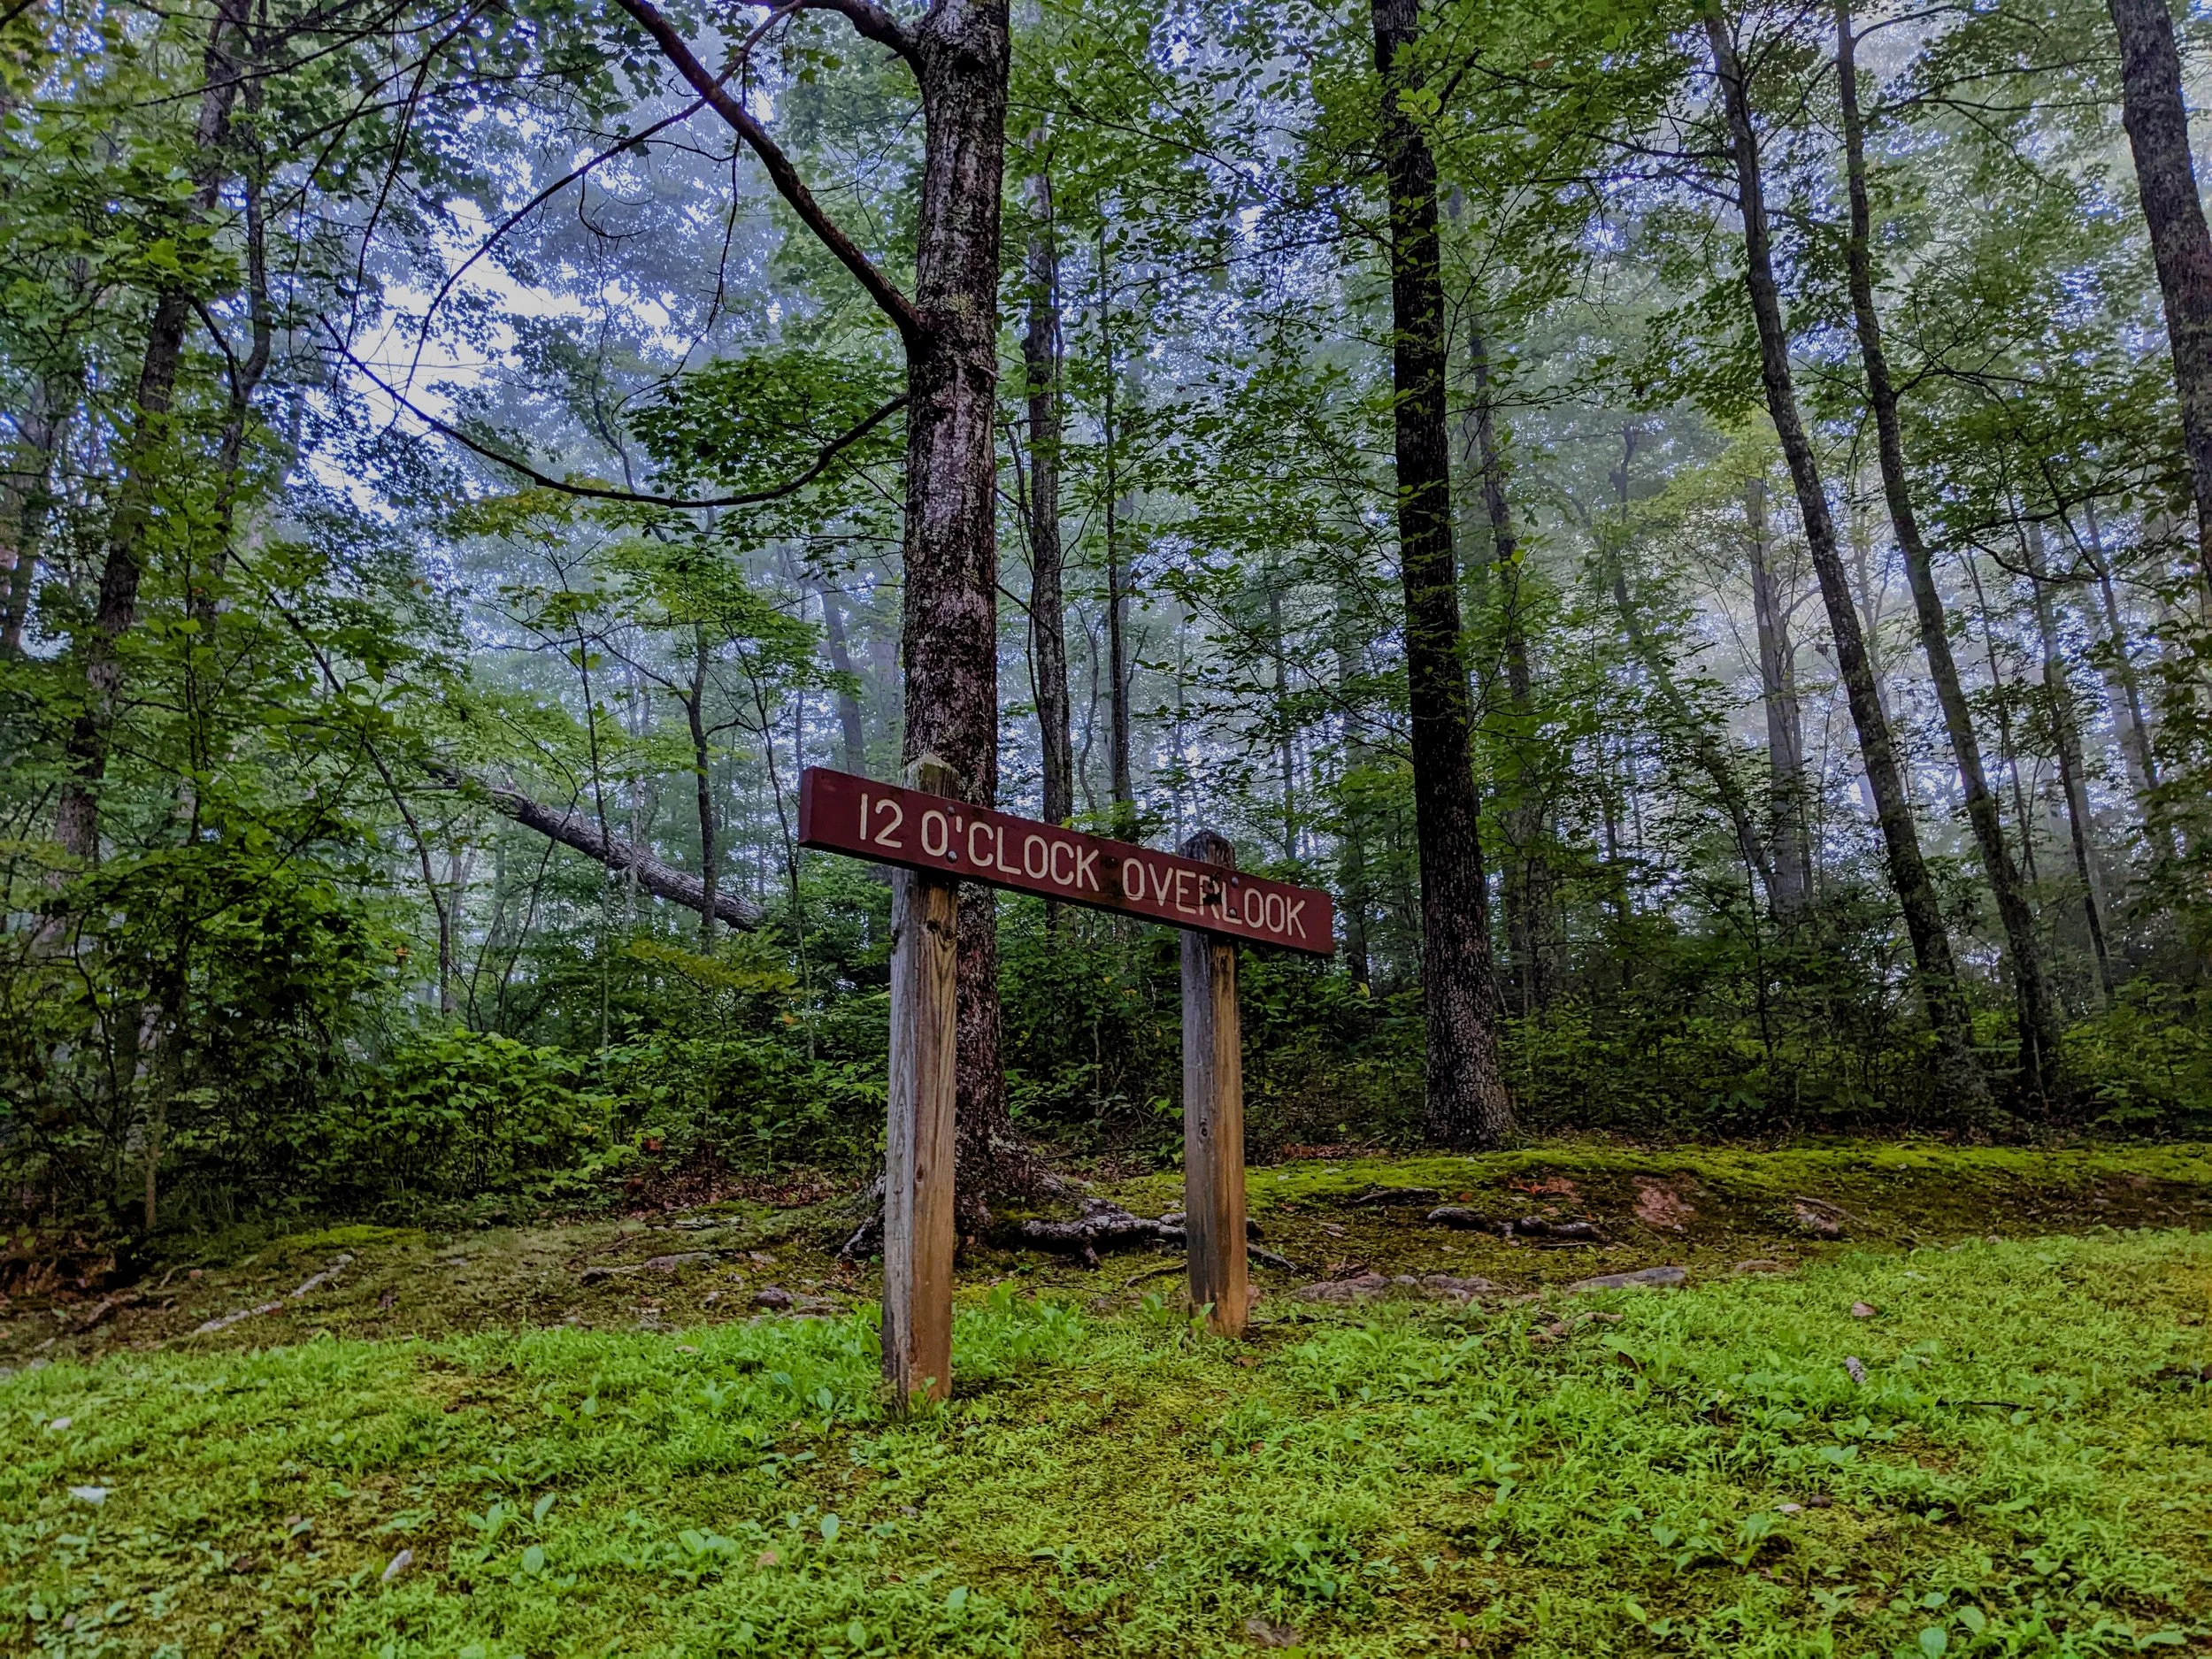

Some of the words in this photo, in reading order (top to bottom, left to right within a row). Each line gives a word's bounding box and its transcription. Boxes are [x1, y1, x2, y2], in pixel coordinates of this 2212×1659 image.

[859, 794, 902, 848] 12
[921, 810, 1100, 891] O'CLOCK
[1123, 858, 1306, 939] OVERLOOK
